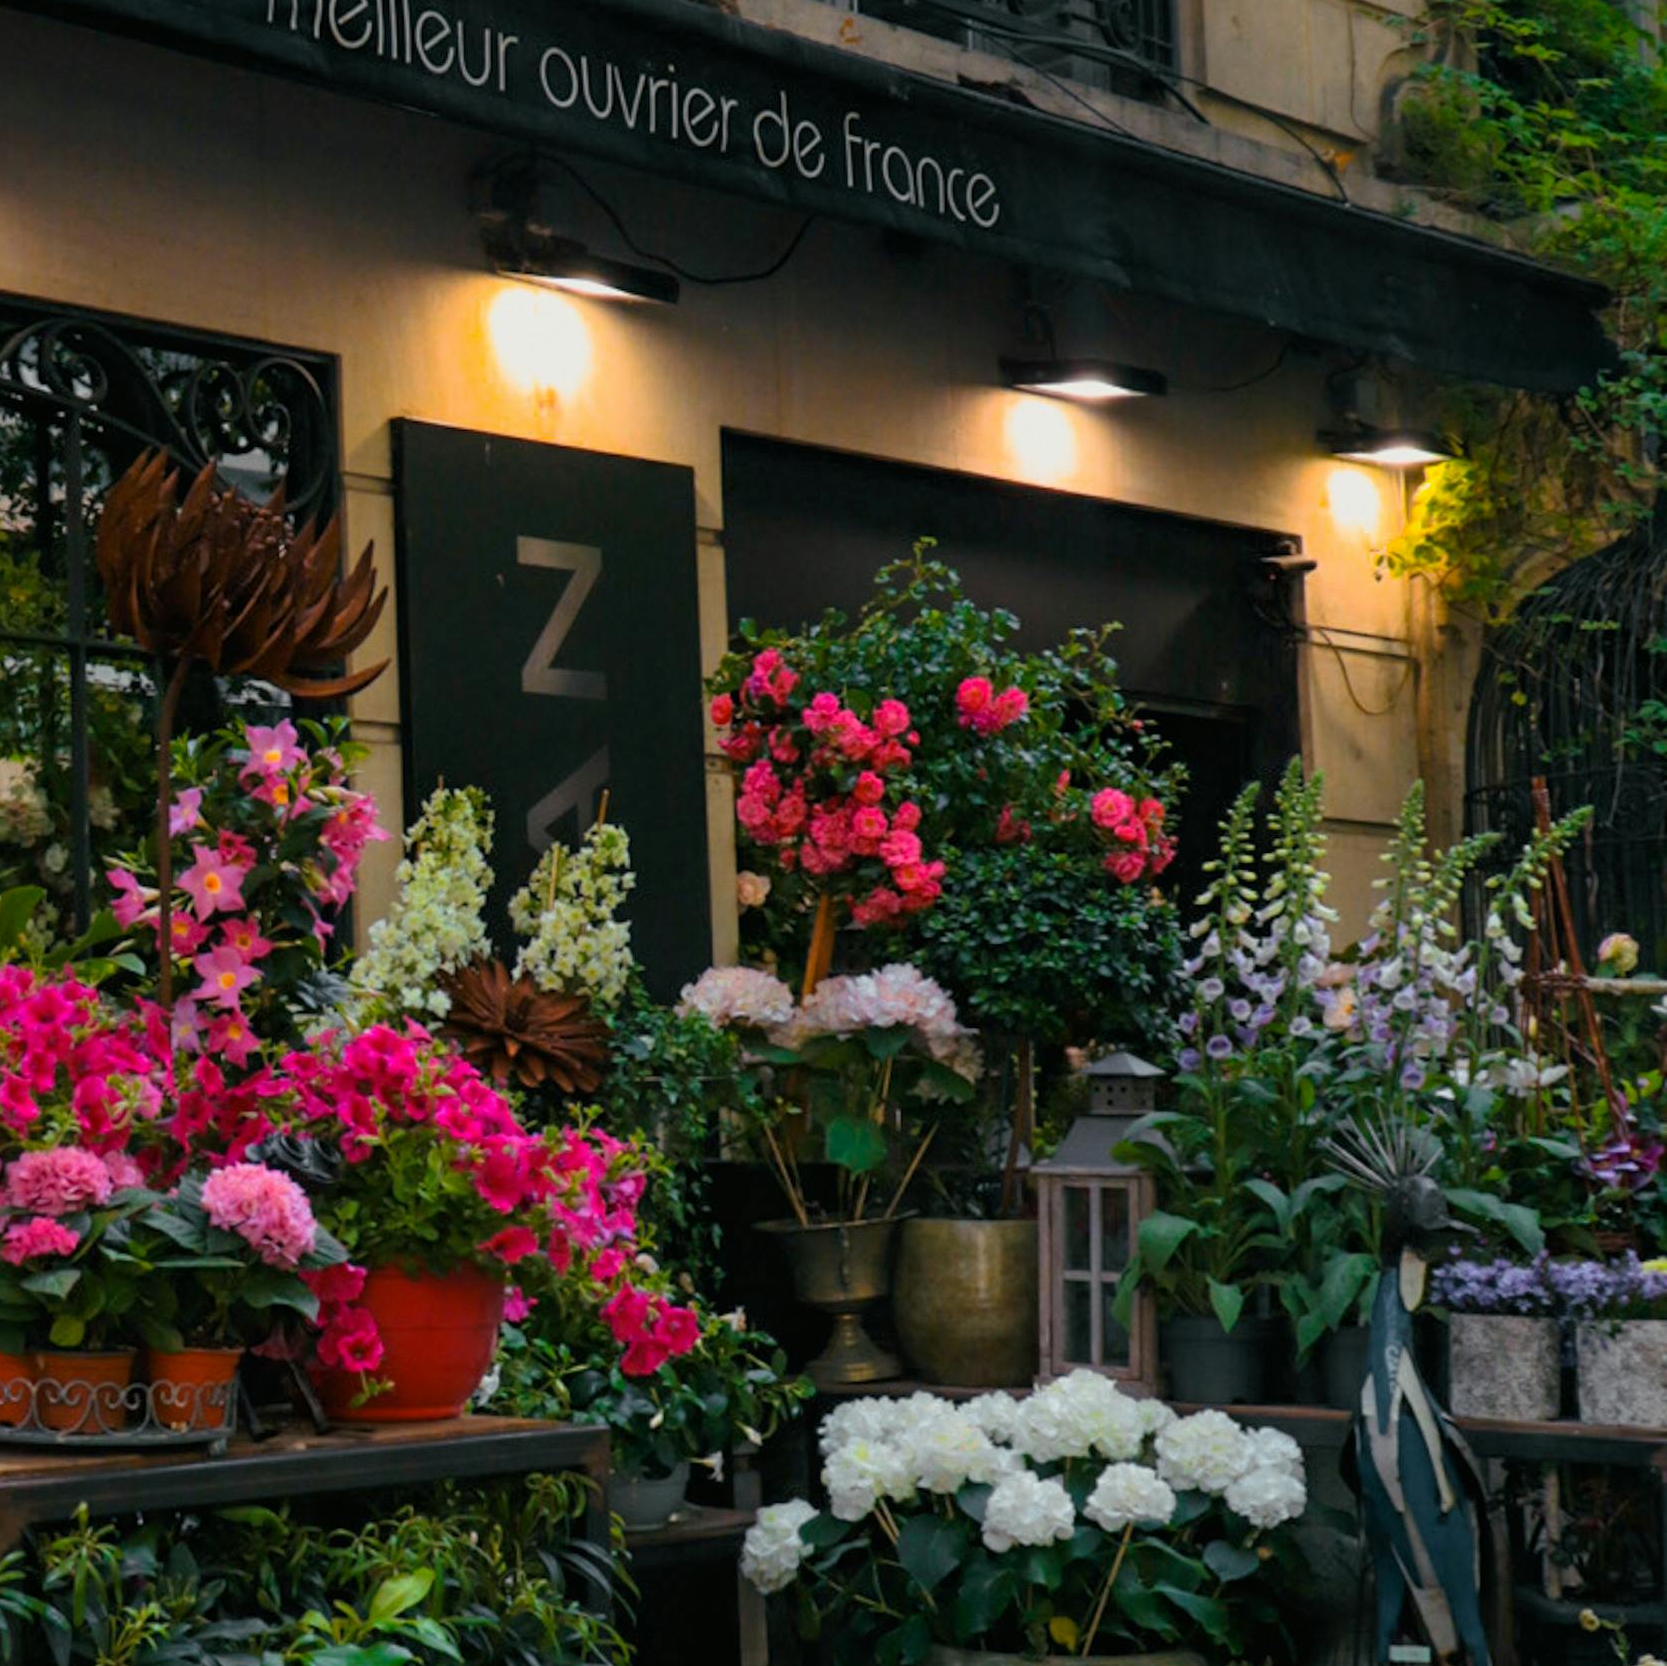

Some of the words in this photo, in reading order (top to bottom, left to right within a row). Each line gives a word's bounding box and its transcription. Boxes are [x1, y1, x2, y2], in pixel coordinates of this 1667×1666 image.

[539, 47, 739, 152] ouvrier
[753, 90, 825, 179] de
[843, 111, 1000, 228] france
